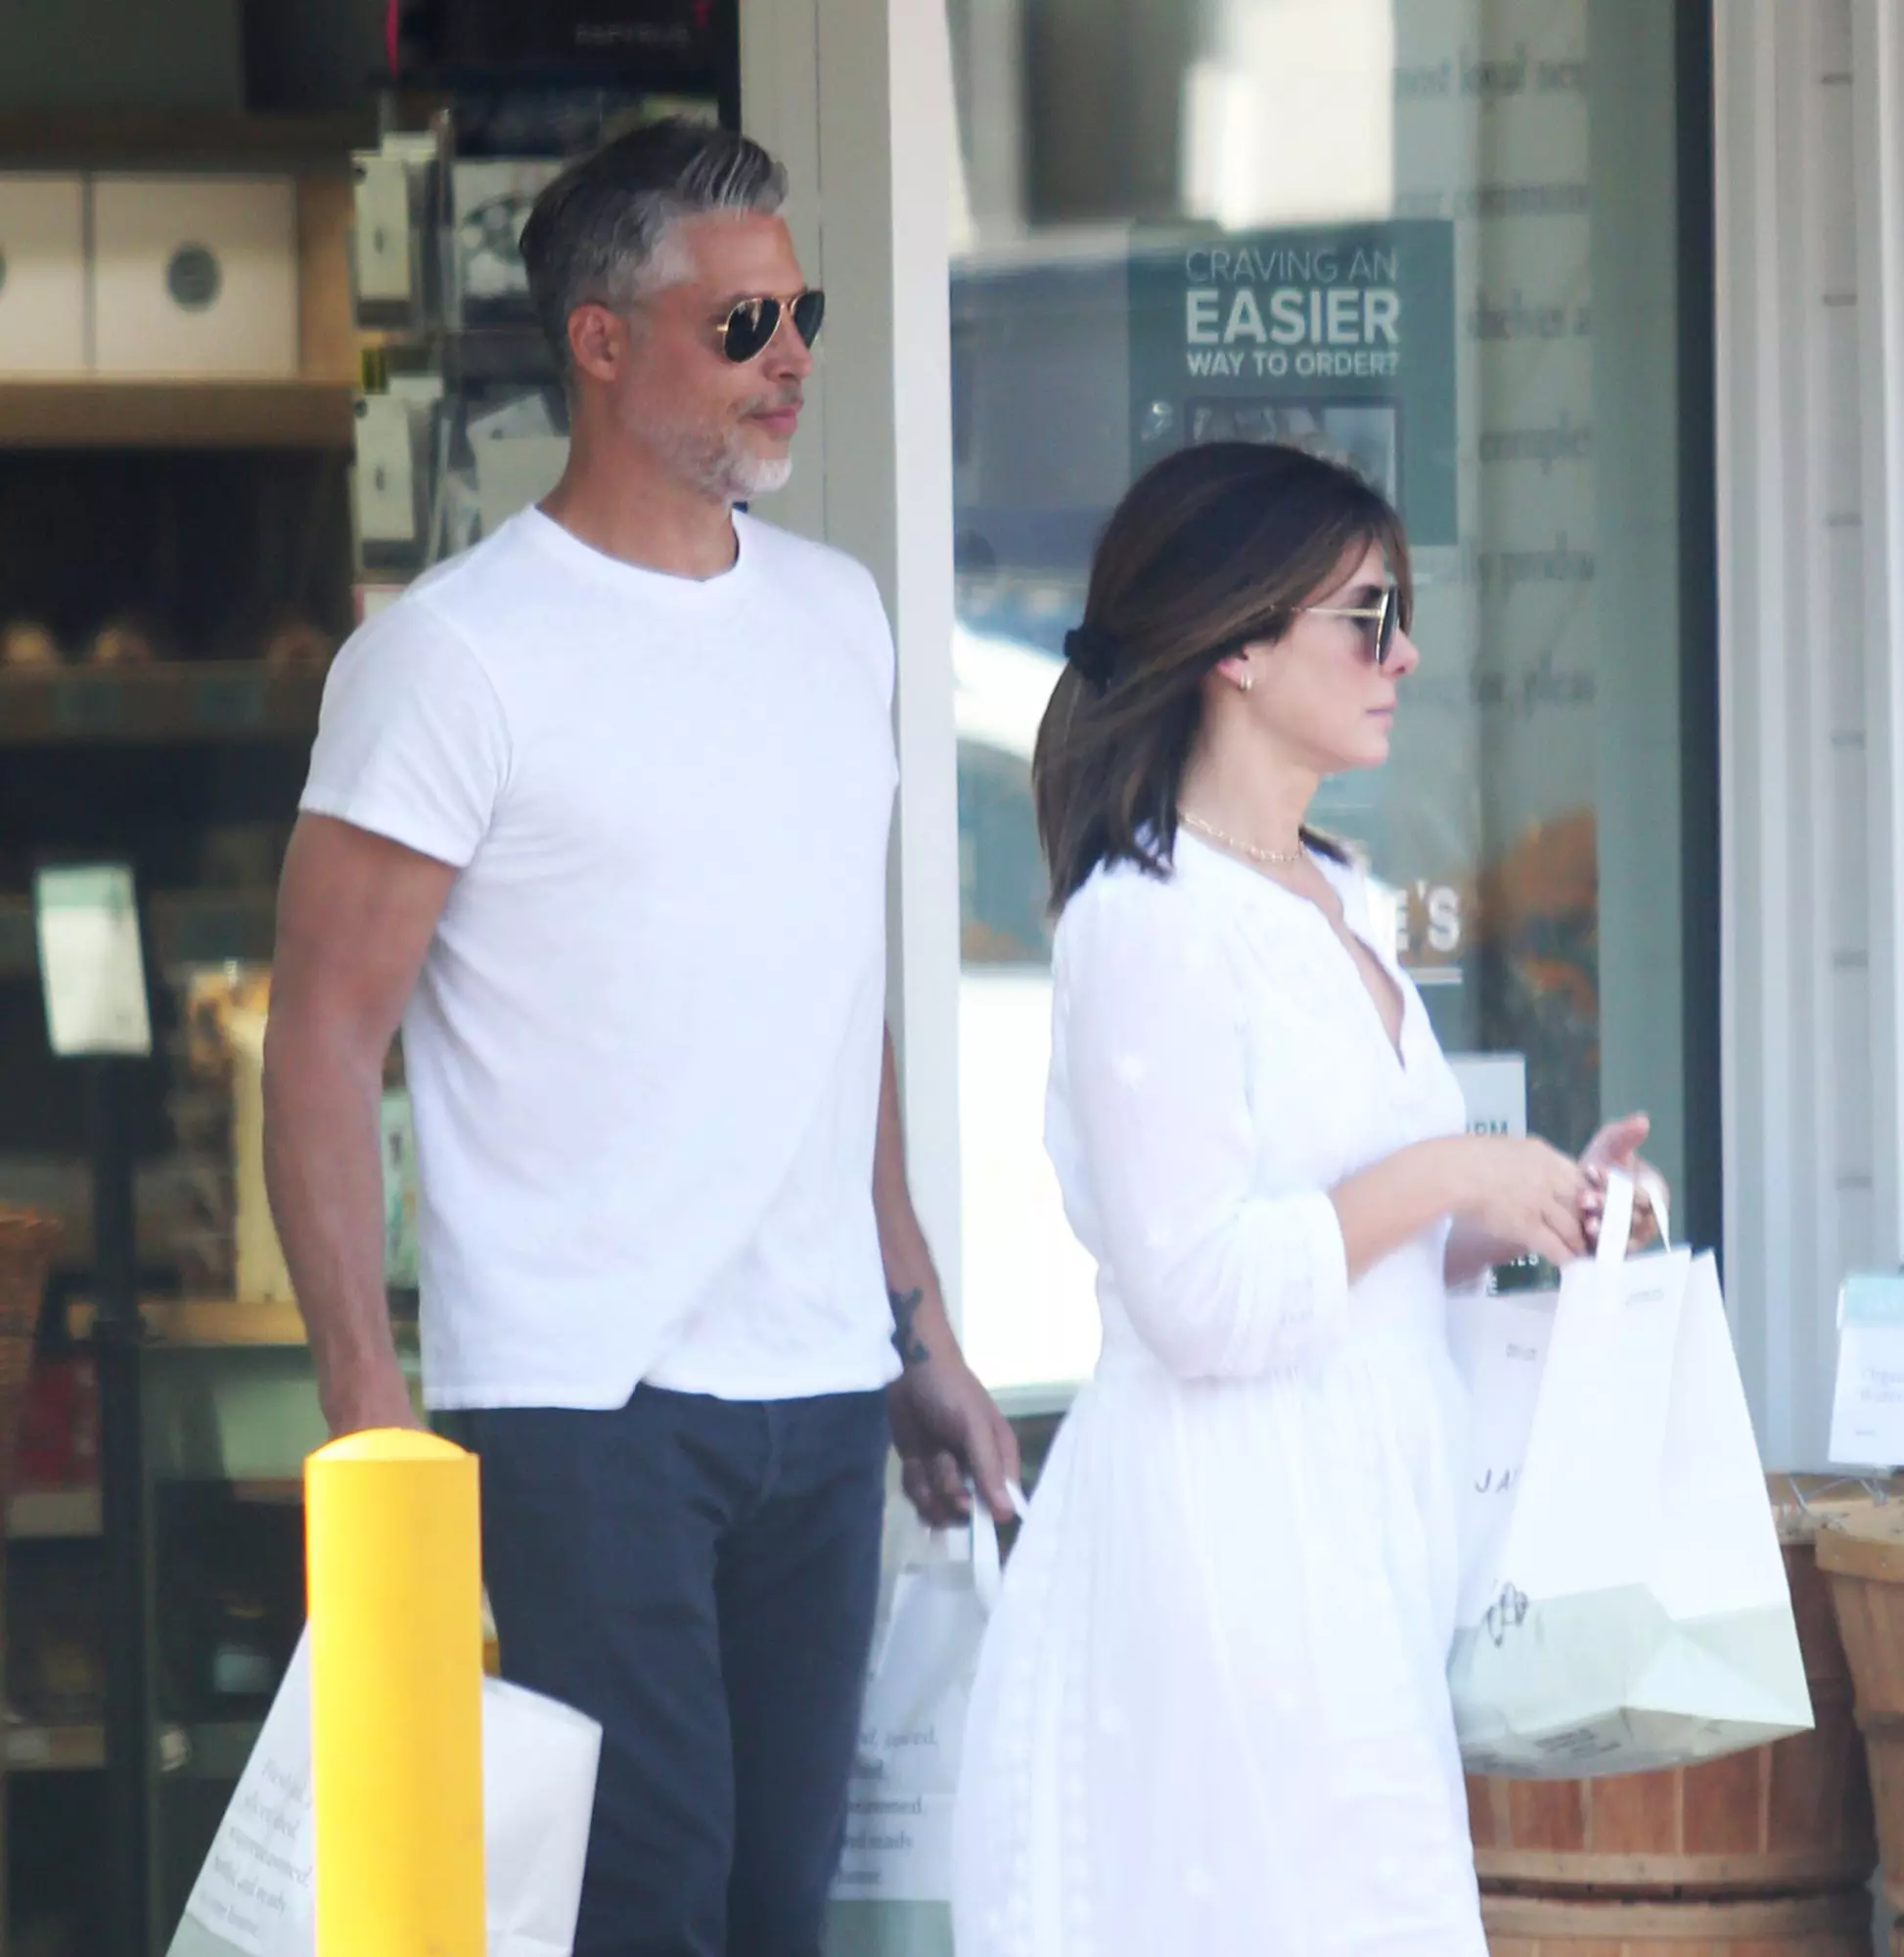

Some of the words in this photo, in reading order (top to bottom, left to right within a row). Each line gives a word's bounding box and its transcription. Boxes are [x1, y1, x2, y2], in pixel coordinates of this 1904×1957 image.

[1186, 248, 1338, 283] CRAVING
[1348, 248, 1398, 282] AN
[1186, 289, 1399, 344] EASIER
[1186, 350, 1245, 377] WAY
[1253, 350, 1288, 377] TO
[1294, 350, 1400, 377] ORDER?
